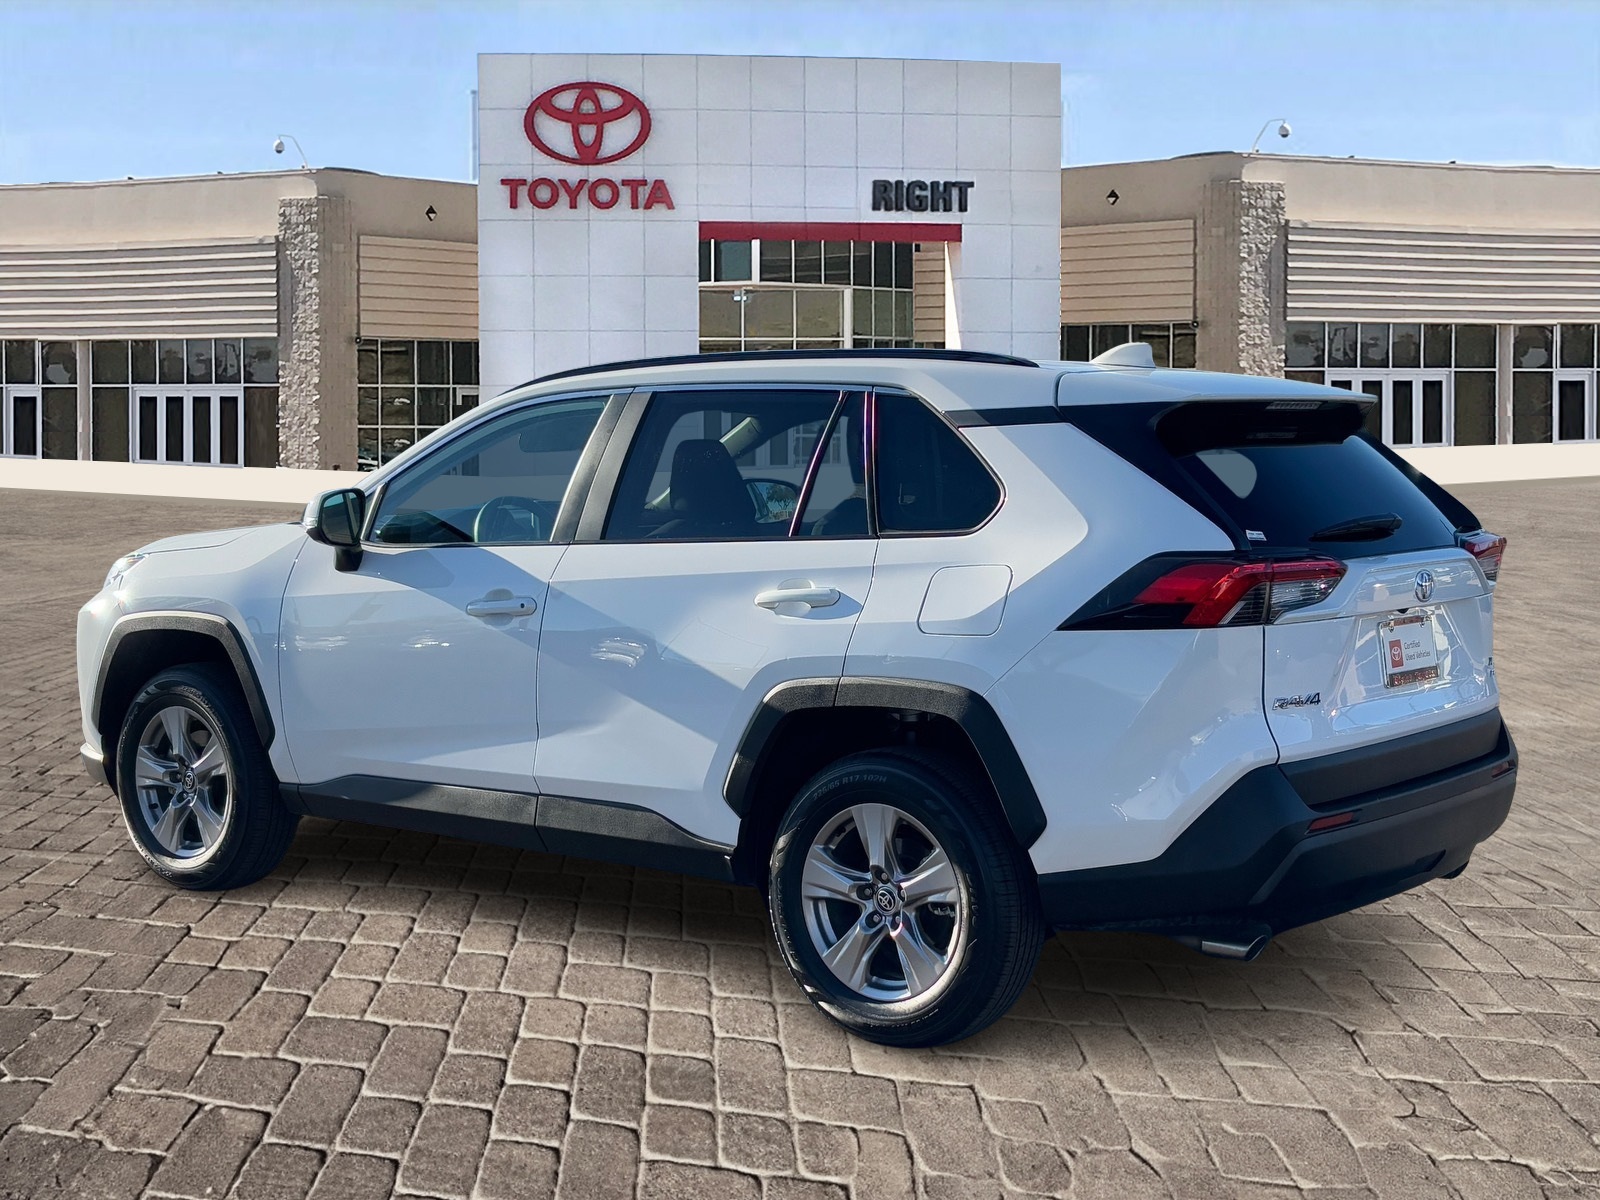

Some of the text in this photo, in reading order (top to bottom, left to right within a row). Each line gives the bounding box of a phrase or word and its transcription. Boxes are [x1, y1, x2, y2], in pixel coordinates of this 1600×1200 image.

[500, 178, 675, 211] TOYOTA
[872, 179, 975, 213] RIGHT
[1404, 640, 1421, 649] Certified
[1405, 650, 1430, 661] Used Vehicles
[1272, 692, 1320, 710] RAV4
[842, 774, 860, 785] R17
